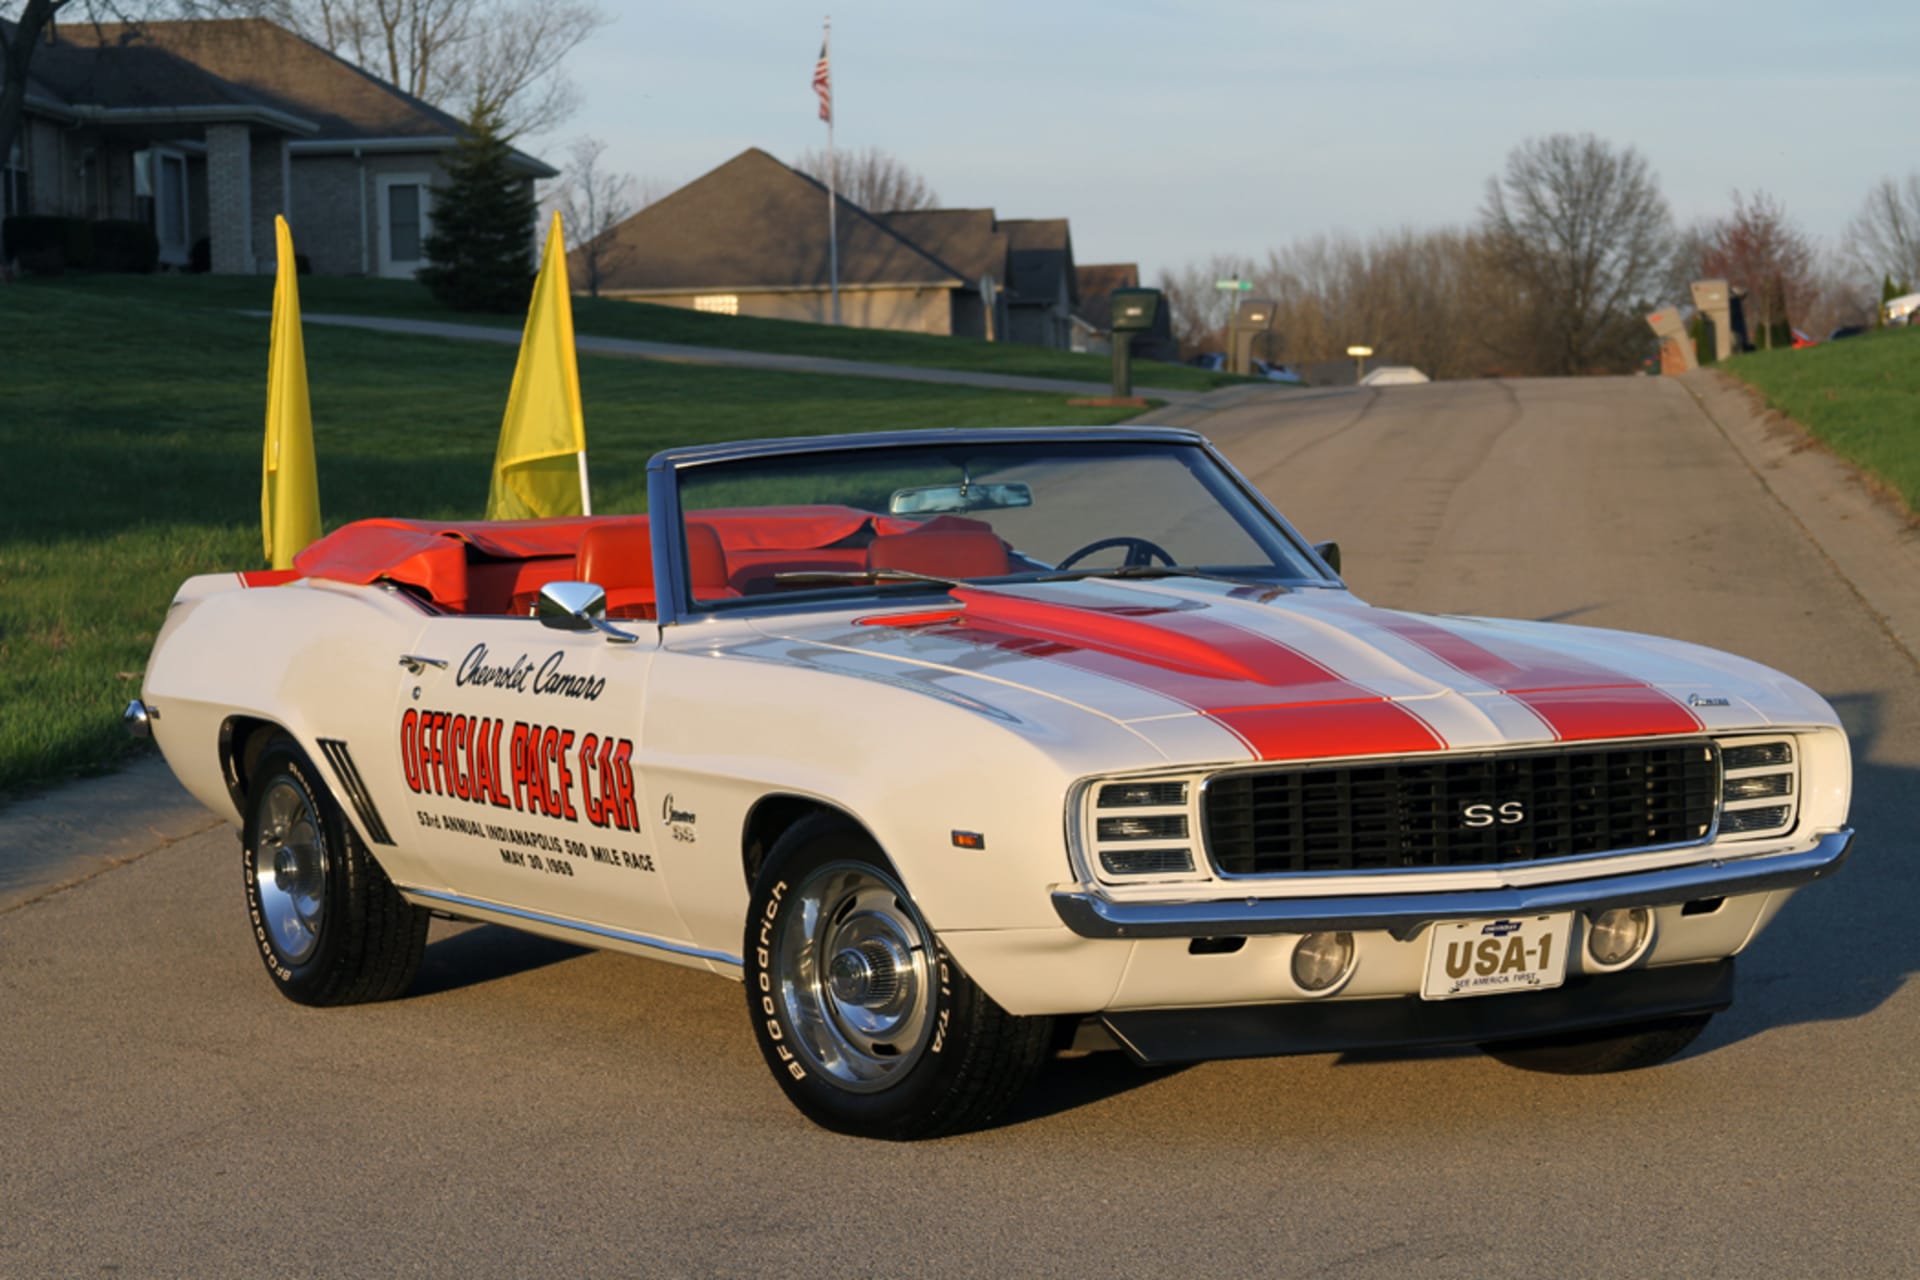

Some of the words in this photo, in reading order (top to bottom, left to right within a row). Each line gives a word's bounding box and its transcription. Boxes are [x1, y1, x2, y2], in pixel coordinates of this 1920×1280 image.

[456, 643, 535, 693] Chevrolet
[533, 650, 606, 701] Camaro
[401, 707, 512, 809] OFFICIAL
[510, 721, 578, 822] PACE
[579, 733, 640, 833] CAR
[1463, 801, 1524, 827] SS
[417, 810, 441, 829] 53rd
[442, 815, 486, 838] ANNUAL
[486, 824, 563, 854] INDIANAPOLIS
[564, 839, 588, 859] 500
[590, 845, 622, 867] MILE
[622, 850, 656, 873] RACE
[500, 848, 526, 868] MAY
[756, 880, 807, 1081] BFGoodrich
[1445, 933, 1552, 979] USA-1
[1472, 975, 1509, 986] AMERICA
